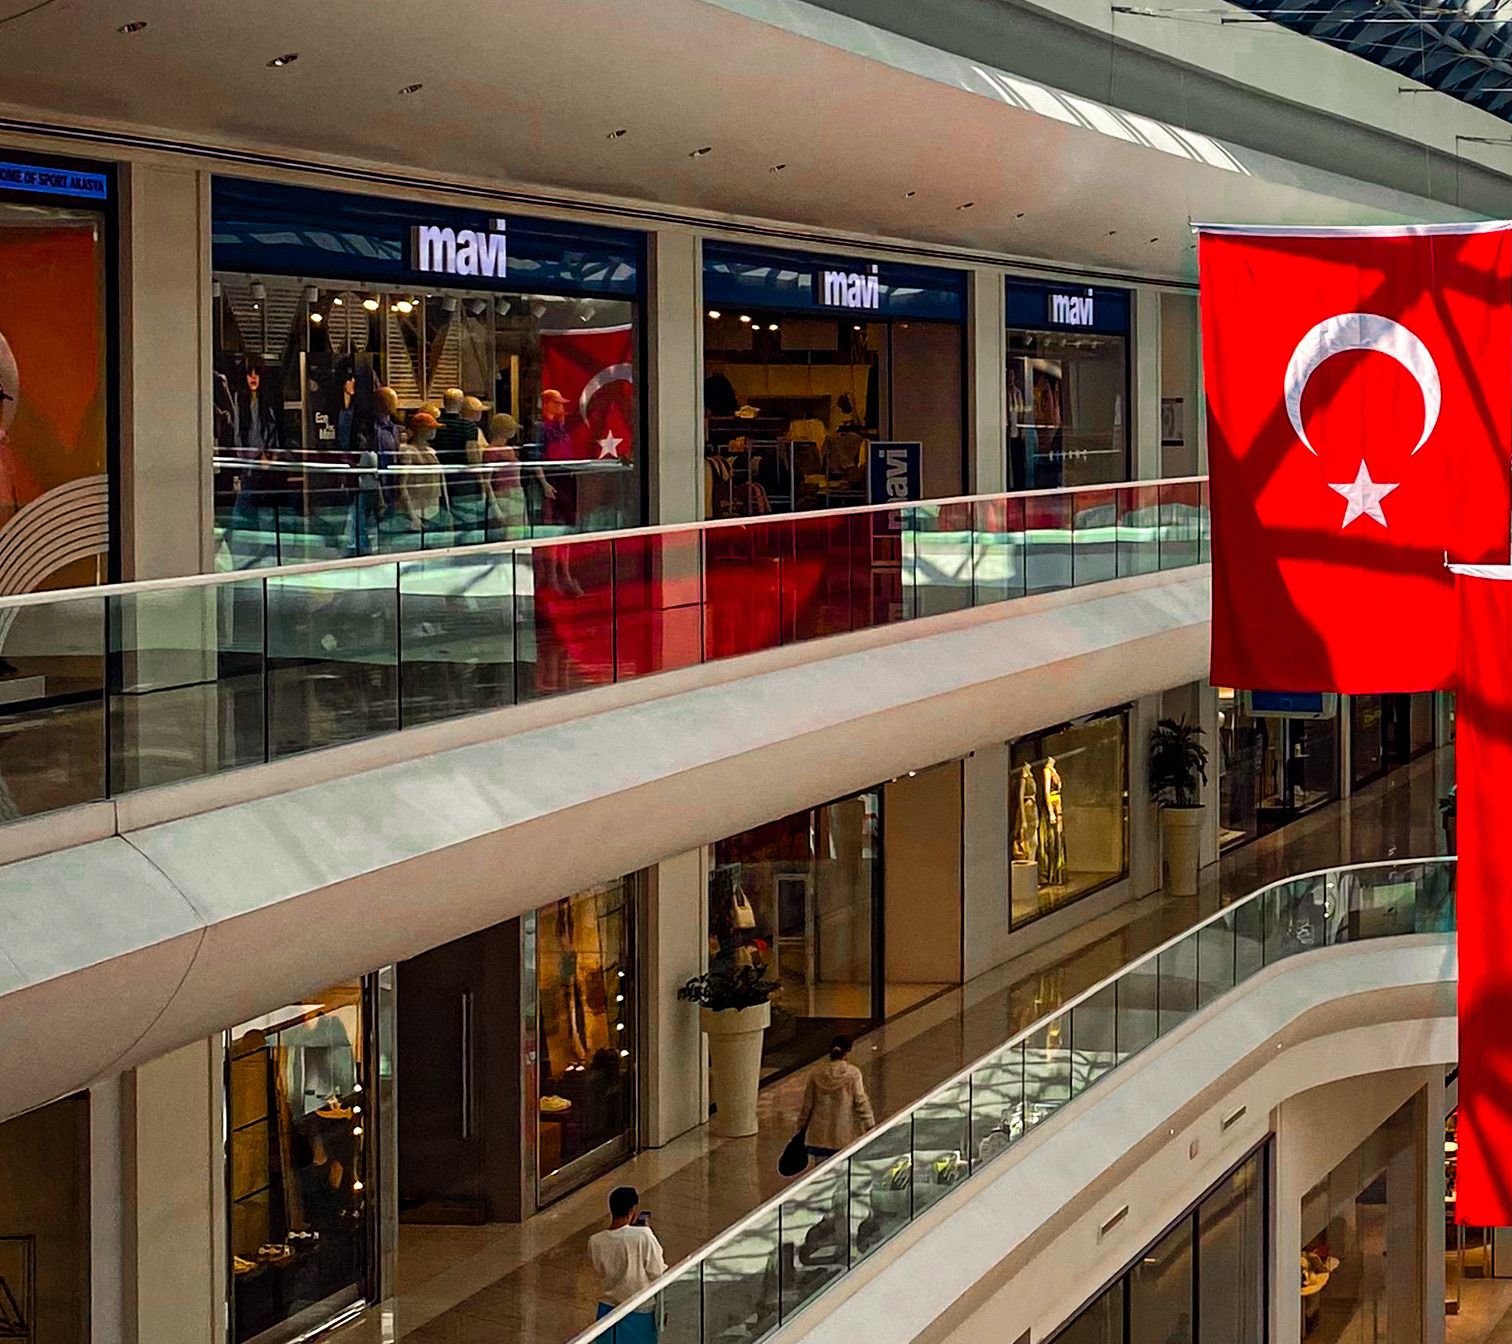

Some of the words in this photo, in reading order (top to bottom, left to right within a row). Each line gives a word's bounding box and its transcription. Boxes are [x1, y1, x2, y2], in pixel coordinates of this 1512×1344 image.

[419, 219, 507, 278] mavi
[823, 264, 879, 309] mavi
[1052, 288, 1094, 326] mavi
[878, 449, 908, 530] mavi
